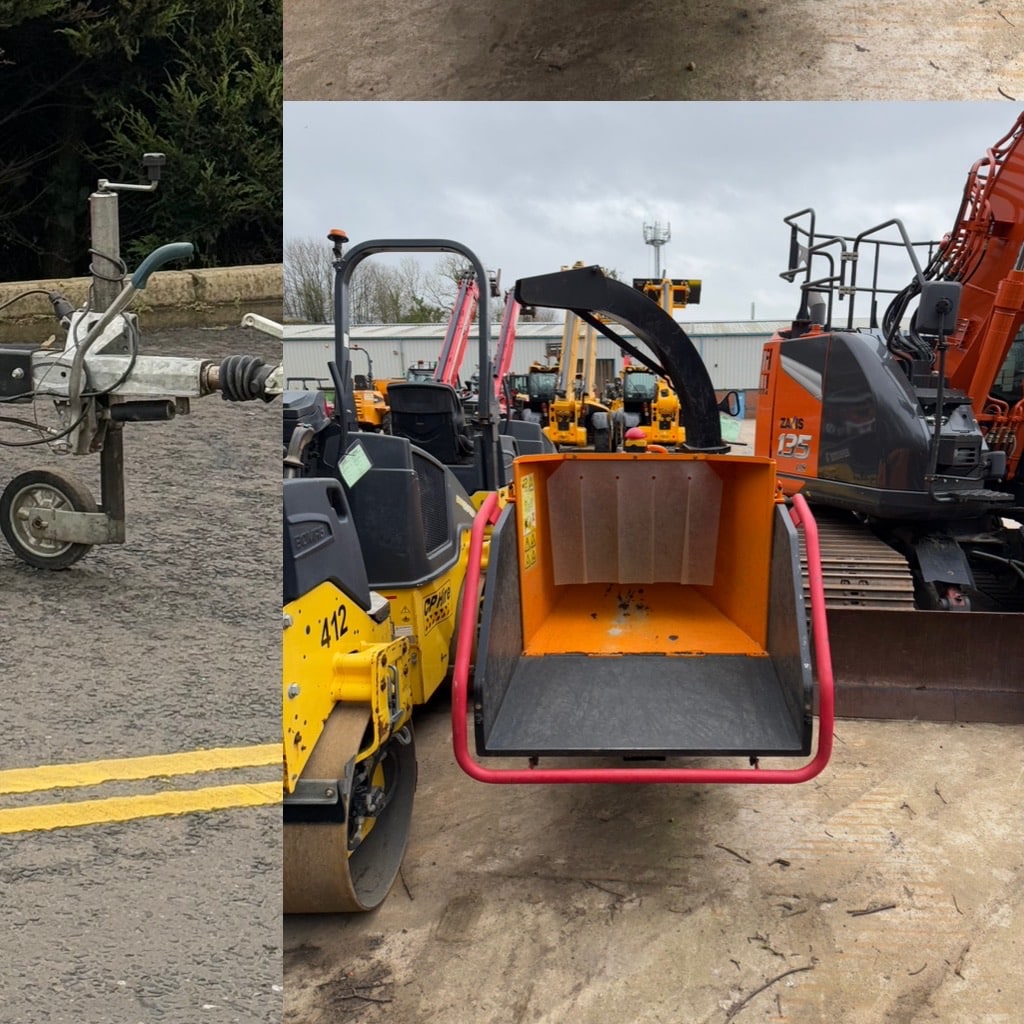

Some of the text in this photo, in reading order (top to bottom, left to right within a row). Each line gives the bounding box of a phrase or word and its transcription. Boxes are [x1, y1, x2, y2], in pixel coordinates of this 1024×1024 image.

[778, 433, 812, 459] 135
[423, 594, 438, 617] CP
[320, 604, 349, 649] 412
